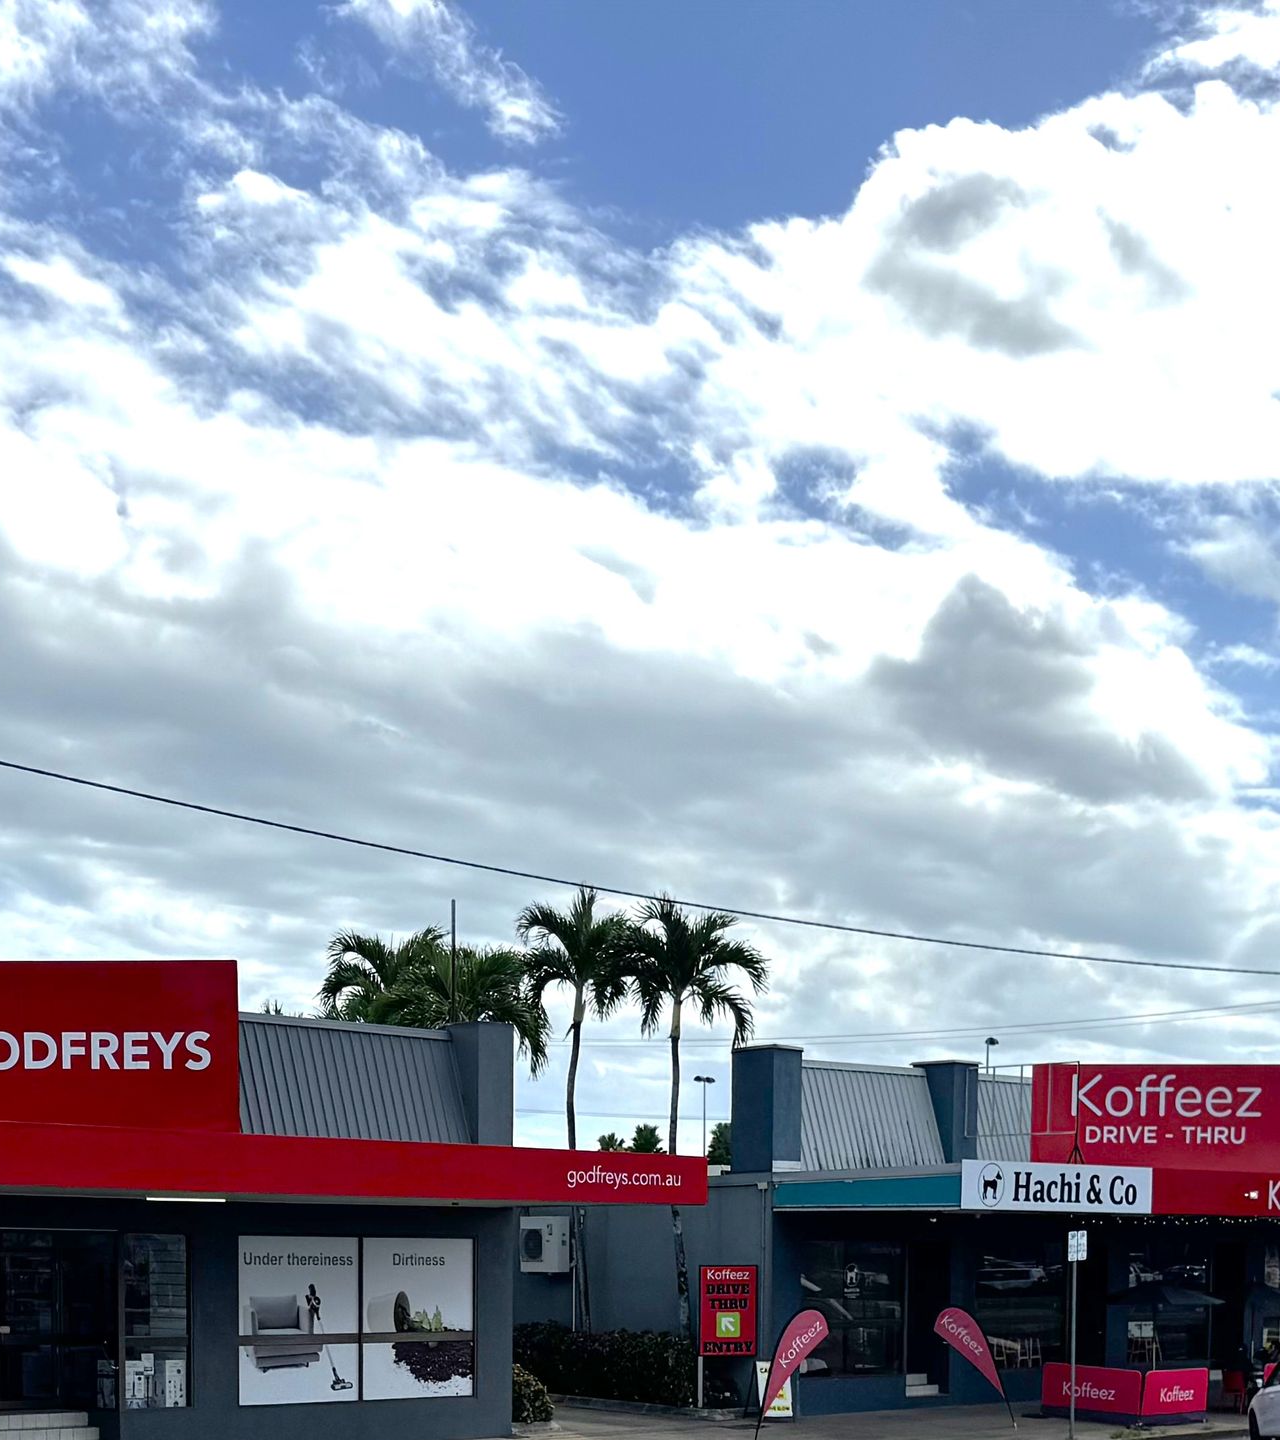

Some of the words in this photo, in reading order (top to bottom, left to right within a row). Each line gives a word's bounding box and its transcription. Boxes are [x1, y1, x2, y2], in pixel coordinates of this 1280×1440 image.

[1071, 1073, 1262, 1118] Koffeez
[1085, 1126, 1158, 1144] DRIVE
[1181, 1126, 1247, 1145] THRU
[567, 1165, 682, 1189] godfreys.com.au
[1012, 1171, 1081, 1204] Hachi
[1086, 1174, 1104, 1205] &
[1109, 1175, 1138, 1206] Co
[243, 1252, 283, 1267] Under
[287, 1252, 354, 1267] thereiness
[392, 1253, 445, 1267] Dirtiness
[706, 1269, 750, 1280] Koffeez
[705, 1283, 750, 1295] DRIVE
[709, 1298, 749, 1310] THRU
[778, 1320, 824, 1369] Koffeez
[940, 1315, 984, 1356] Koffeez
[703, 1341, 753, 1353] ENTRY
[1062, 1381, 1115, 1401] Koffeez
[1159, 1385, 1195, 1403] Koffeez
